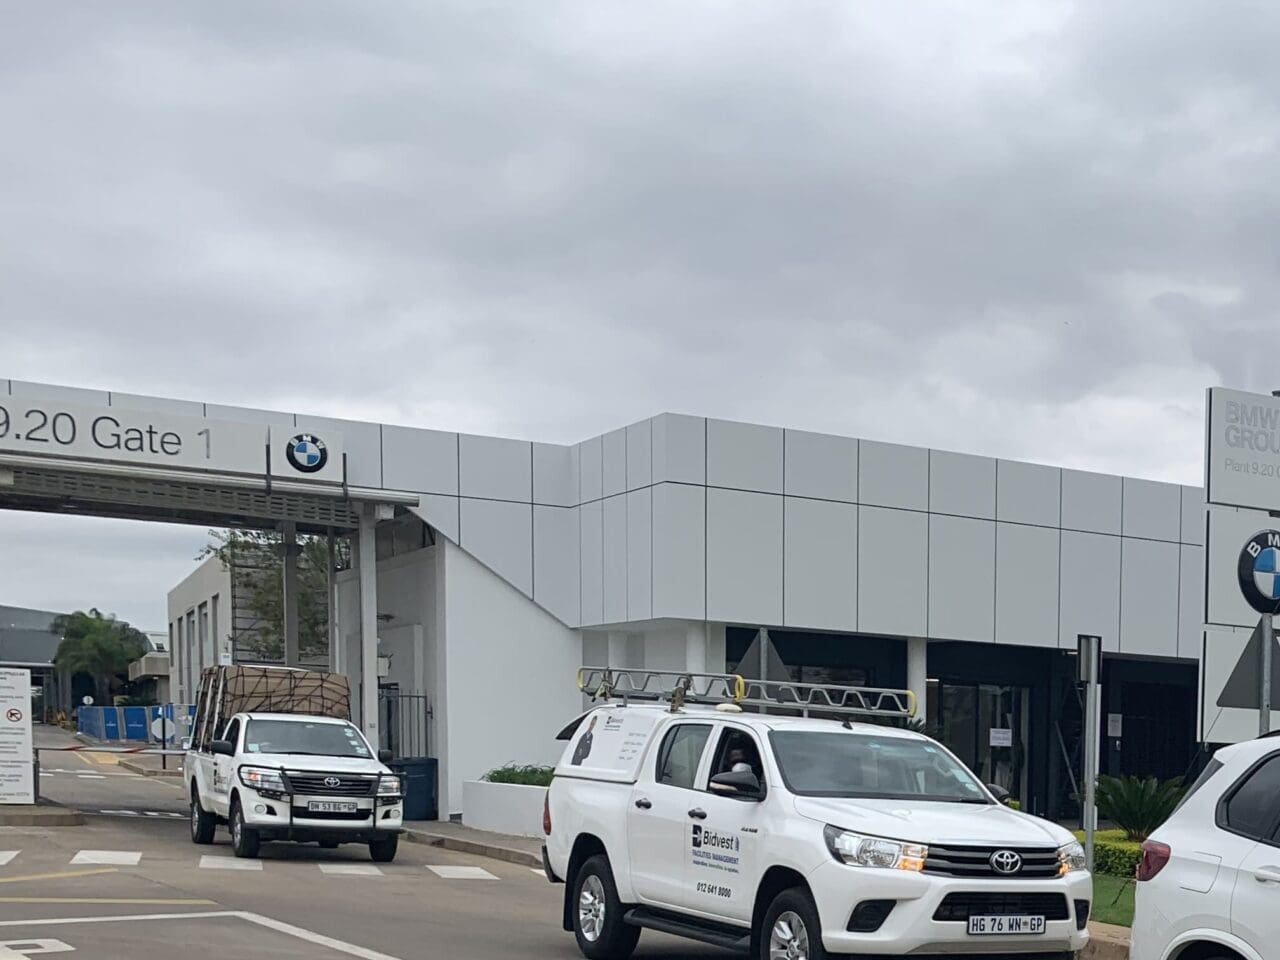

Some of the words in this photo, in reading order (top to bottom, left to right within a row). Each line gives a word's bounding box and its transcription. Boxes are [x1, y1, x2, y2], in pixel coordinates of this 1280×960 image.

[1224, 401, 1280, 430] BMW
[91, 416, 182, 455] Gate
[197, 428, 210, 459] 1
[1224, 458, 1250, 473] Plant
[703, 831, 734, 850] Bidvest
[697, 882, 707, 893] 012
[971, 918, 985, 931] HG
[990, 918, 1003, 931] 76
[1008, 918, 1021, 931] WN
[1030, 917, 1042, 931] GP
